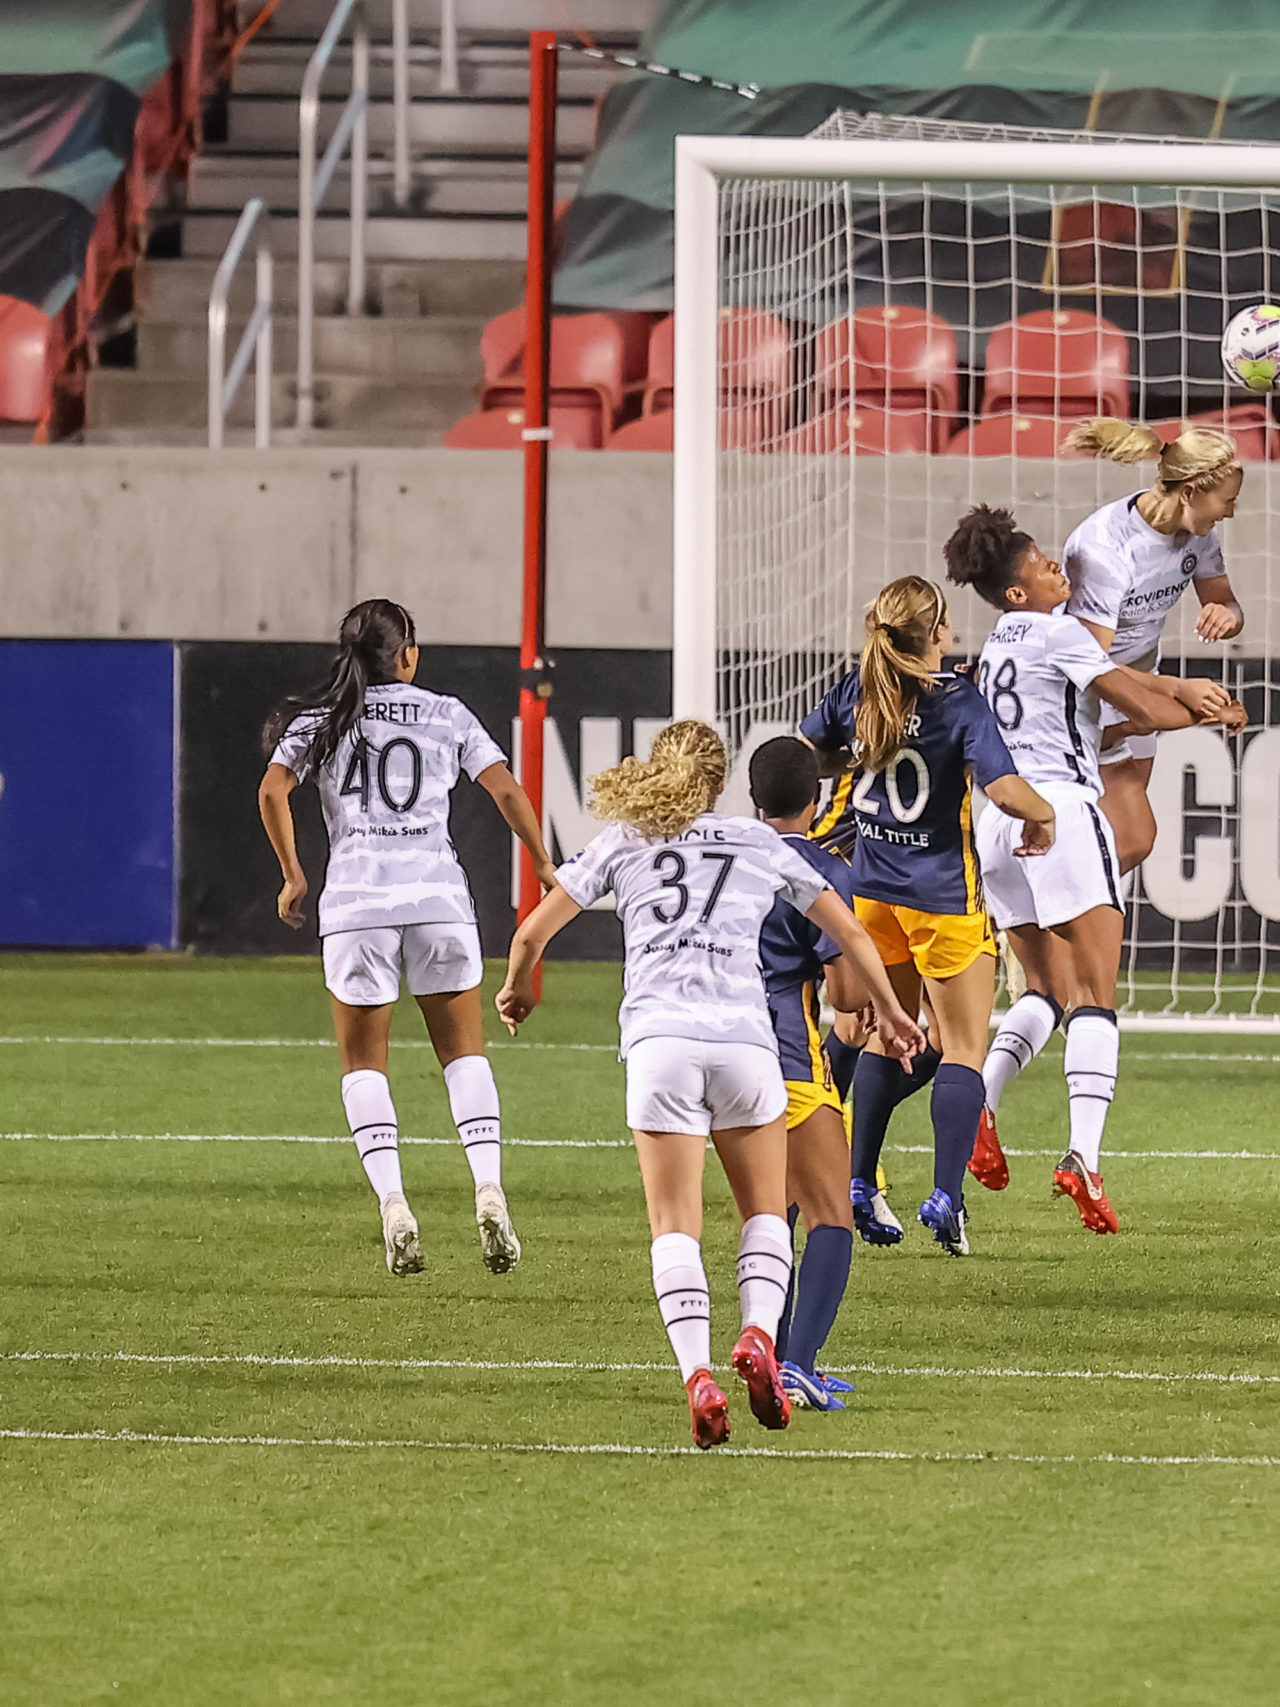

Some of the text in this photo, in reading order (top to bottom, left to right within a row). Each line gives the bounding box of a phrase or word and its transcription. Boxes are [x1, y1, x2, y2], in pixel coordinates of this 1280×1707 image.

[364, 702, 421, 723] ERETT
[340, 736, 422, 814] 40
[852, 747, 930, 824] 20
[885, 828, 930, 848] TITLE
[652, 849, 736, 924] 37
[467, 1126, 495, 1137] PTFC
